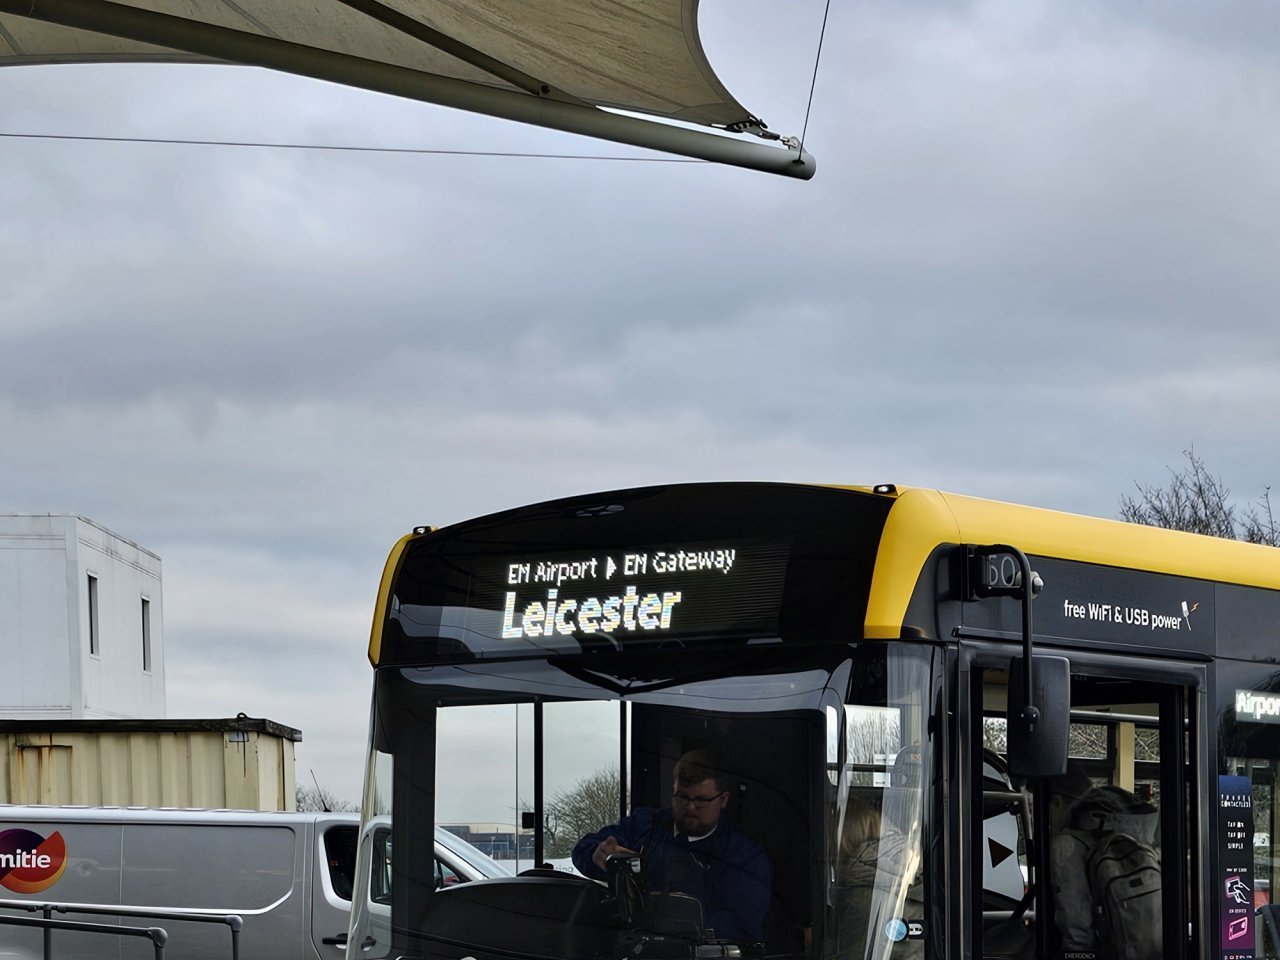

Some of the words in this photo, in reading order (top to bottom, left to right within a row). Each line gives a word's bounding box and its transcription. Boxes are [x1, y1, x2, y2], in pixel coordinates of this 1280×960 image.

[508, 563, 530, 584] EM
[534, 558, 598, 586] Airport
[623, 553, 648, 576] EM
[652, 549, 736, 574] Gateway
[502, 586, 682, 639] Leicester
[1064, 599, 1085, 618] free
[1088, 602, 1112, 622] WiFi
[1114, 606, 1123, 623] &
[1125, 607, 1149, 626] USB
[1151, 614, 1181, 631] power
